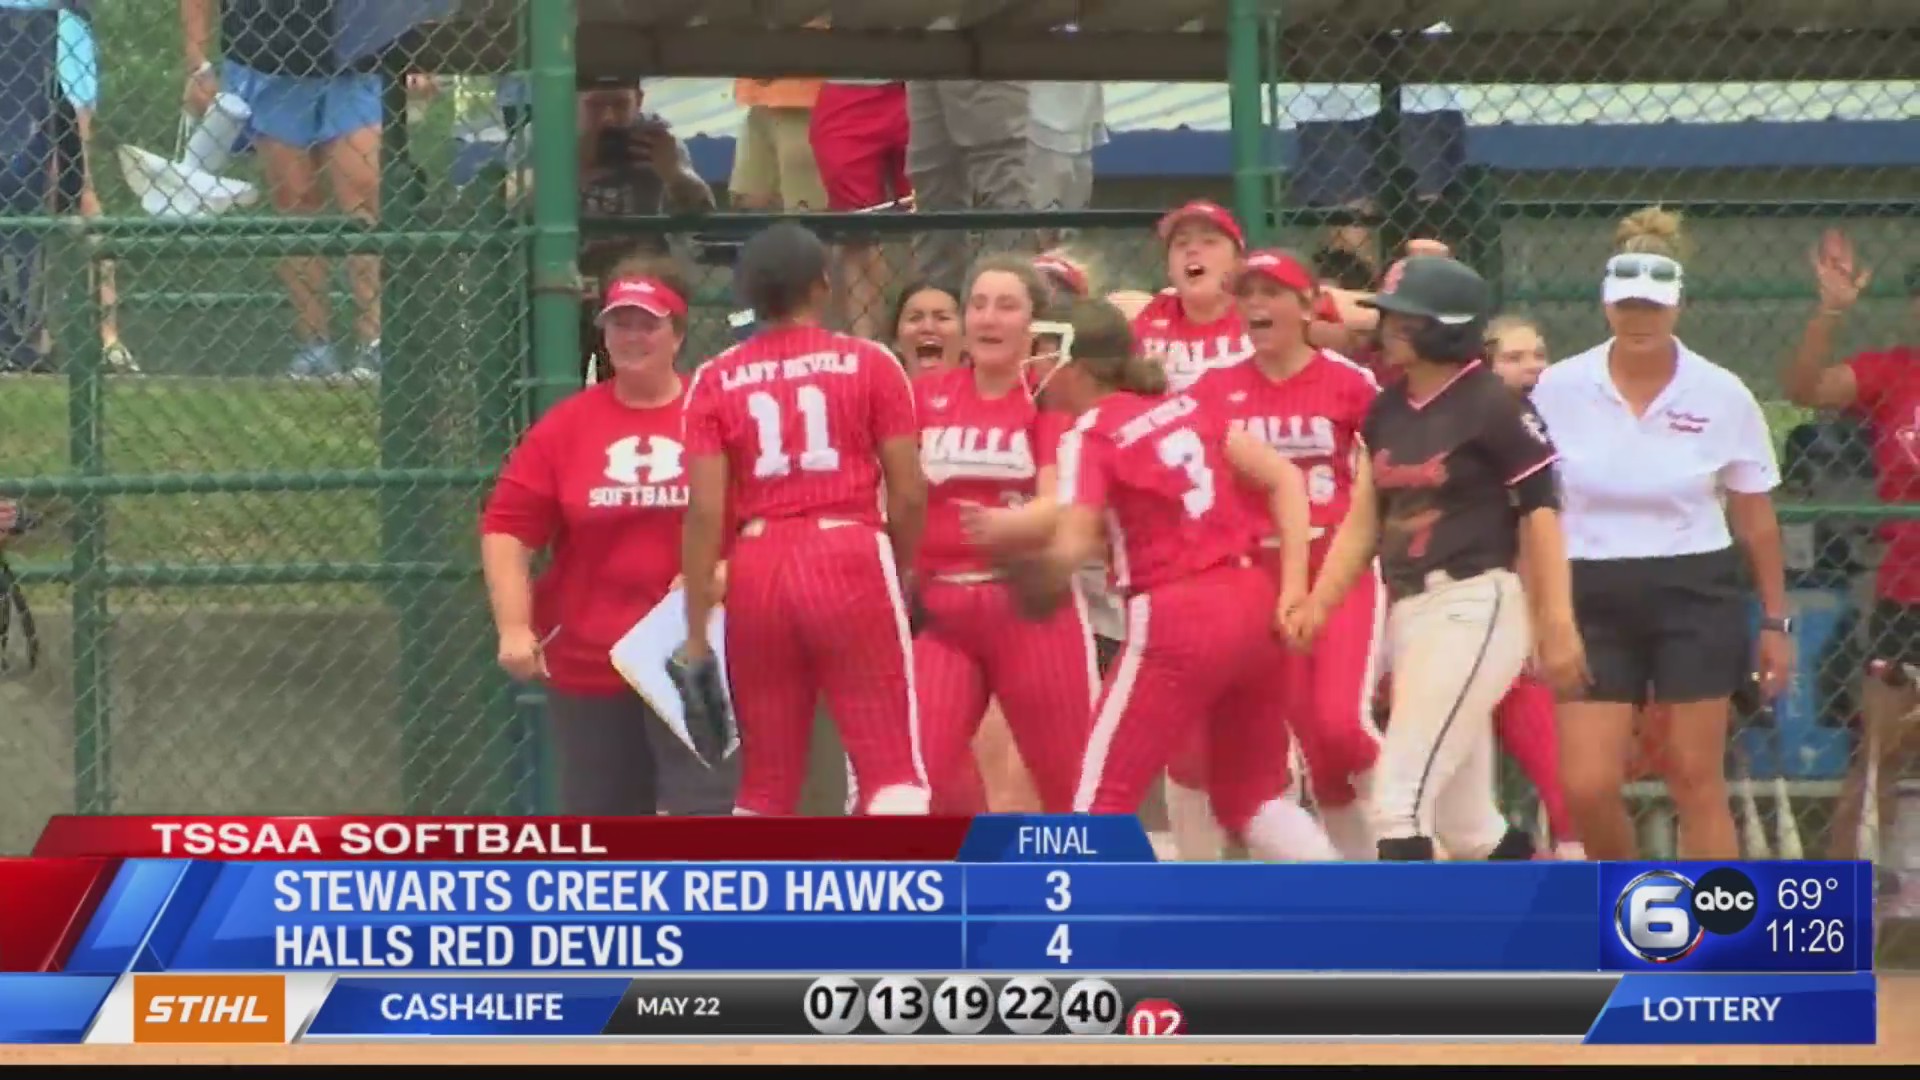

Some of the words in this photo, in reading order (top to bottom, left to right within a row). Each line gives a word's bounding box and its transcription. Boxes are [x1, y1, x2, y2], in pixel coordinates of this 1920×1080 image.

[720, 361, 777, 391] LADY
[783, 352, 859, 379] DEVILS
[604, 435, 685, 484] H
[748, 384, 840, 478] 11
[1158, 428, 1215, 519] 3
